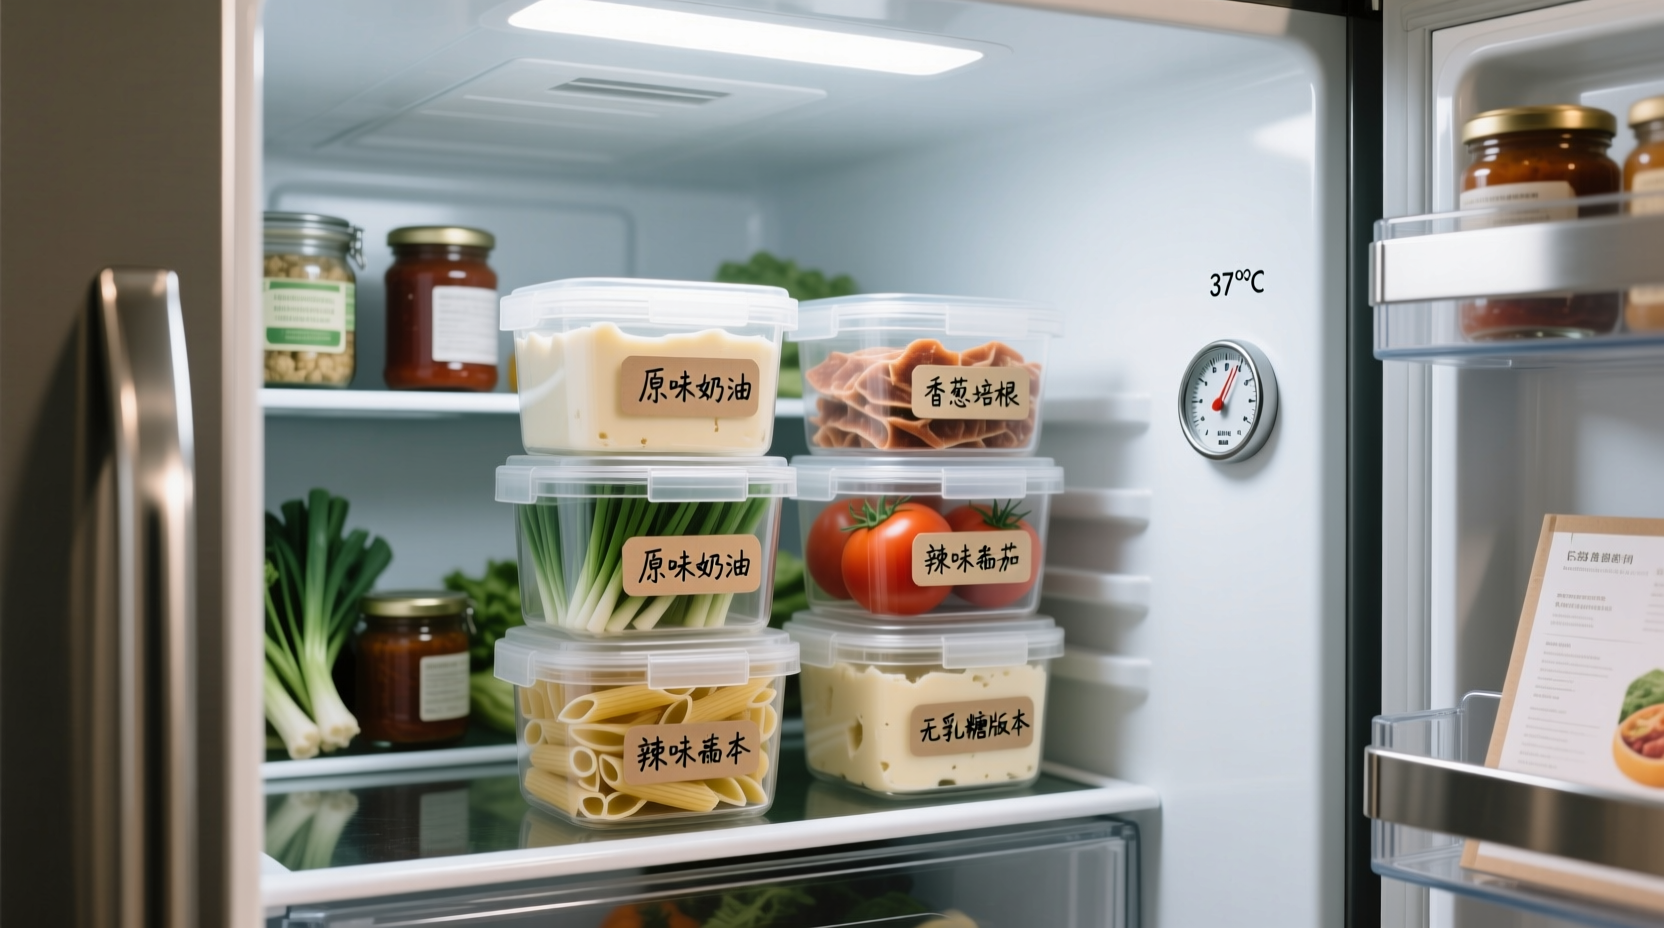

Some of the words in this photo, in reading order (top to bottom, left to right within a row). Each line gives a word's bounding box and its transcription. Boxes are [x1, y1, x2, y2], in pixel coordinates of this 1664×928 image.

[638, 367, 752, 404] 原味奶油
[924, 376, 1020, 408] 香葱培根
[638, 548, 751, 584] 原味奶油
[920, 708, 1031, 743] 无乳糖版本
